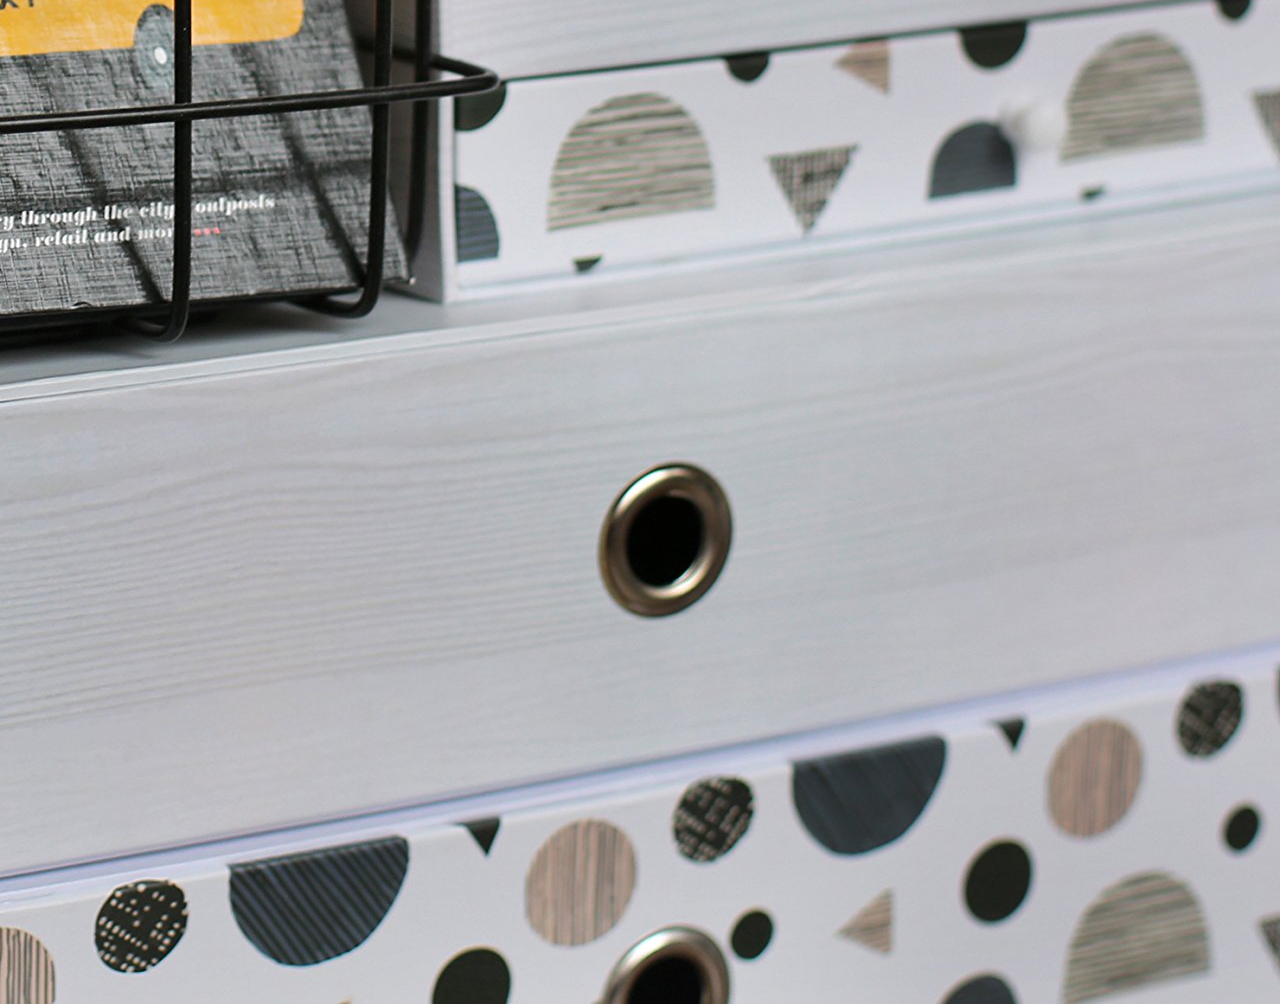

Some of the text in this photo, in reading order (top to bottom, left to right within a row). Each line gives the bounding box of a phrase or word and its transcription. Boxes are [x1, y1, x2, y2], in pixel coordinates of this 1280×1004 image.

[21, 205, 98, 226] through
[104, 203, 133, 221] the
[194, 193, 276, 216] outposts
[35, 228, 89, 248] retail
[93, 225, 131, 245] and
